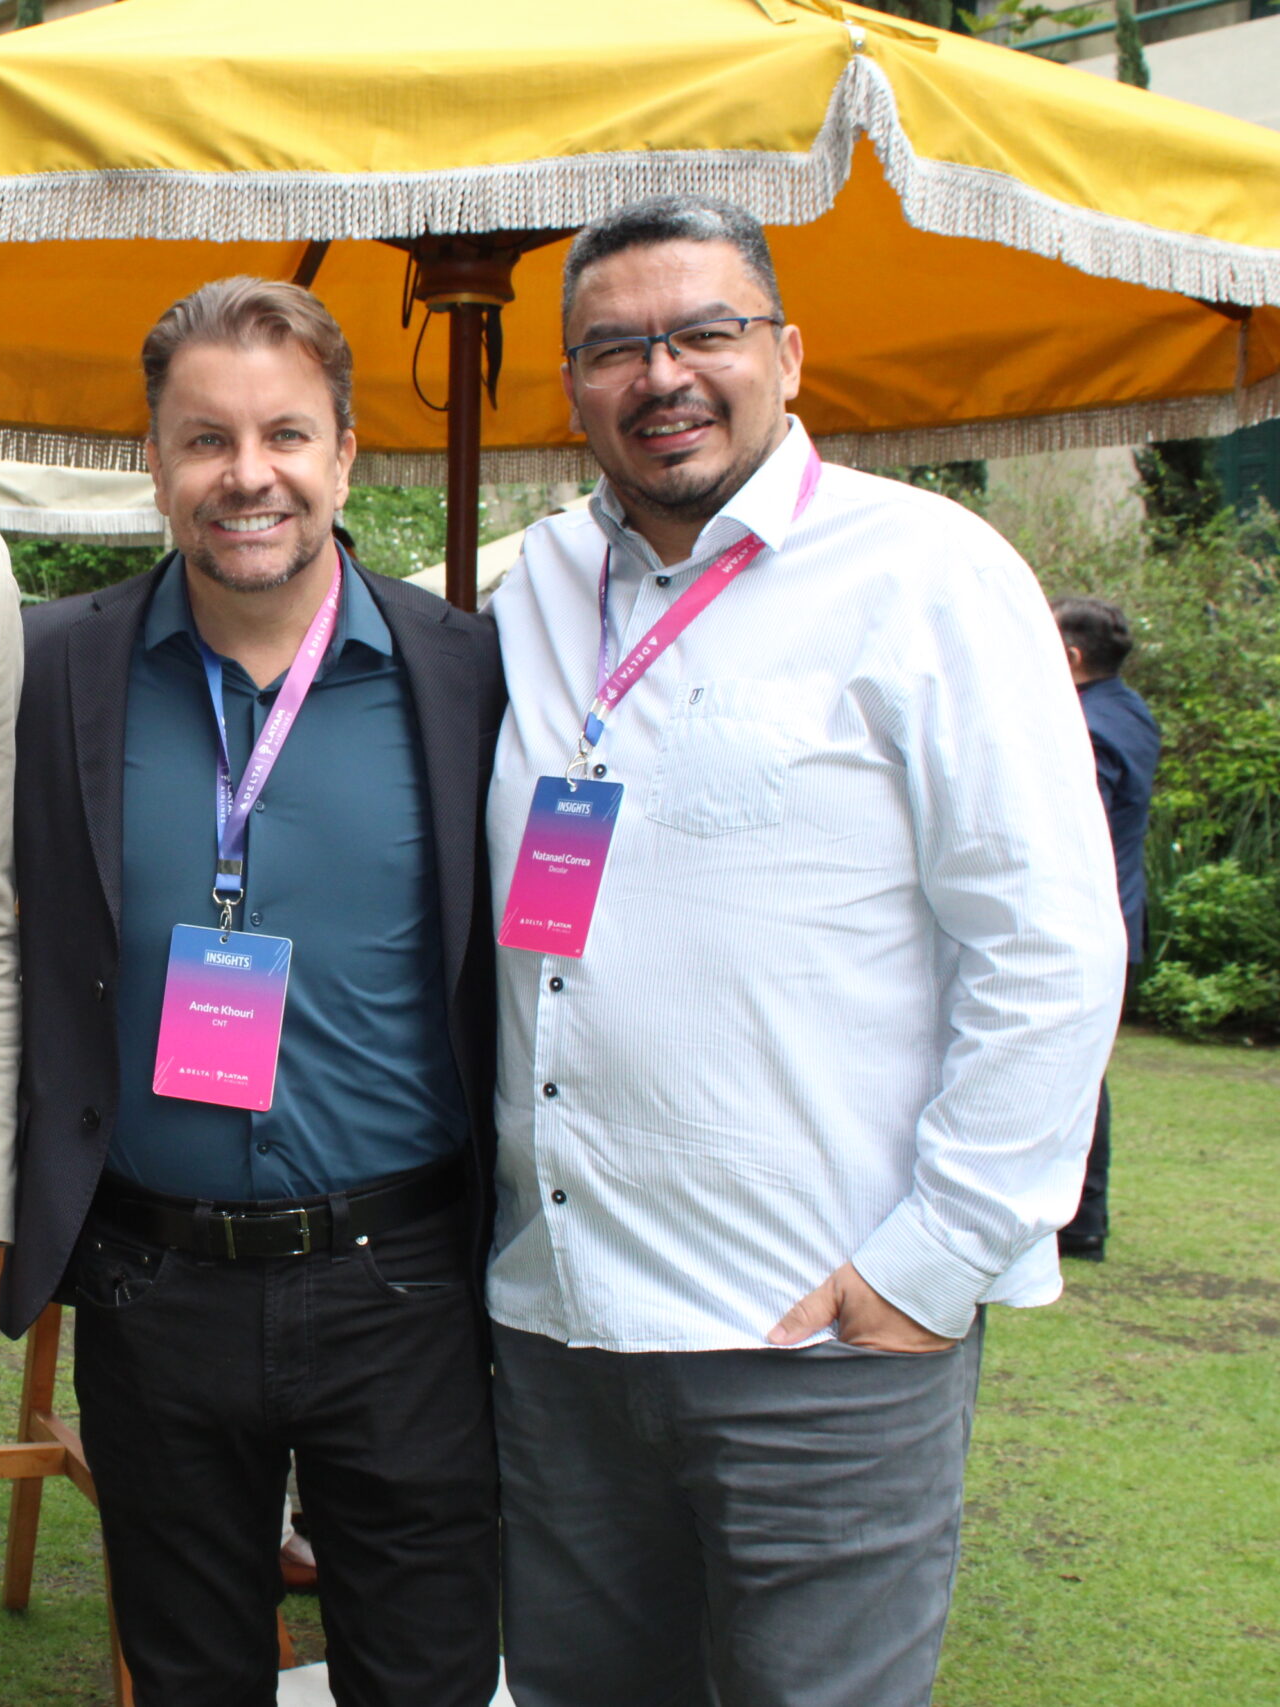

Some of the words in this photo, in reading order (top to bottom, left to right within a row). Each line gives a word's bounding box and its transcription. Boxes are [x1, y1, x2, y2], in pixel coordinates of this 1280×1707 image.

[311, 617, 331, 648] DELTA
[619, 646, 651, 679] DELTA
[274, 711, 294, 748] AIRLINES
[243, 764, 264, 801] DELTA
[264, 708, 286, 745] LATAM
[557, 801, 591, 814] INSIGHTS
[532, 850, 565, 863] Natanael
[565, 854, 591, 867] Correa
[524, 918, 543, 926] DELTA
[552, 921, 572, 929] LATAM
[206, 952, 251, 968] INSIGHTS
[189, 1001, 220, 1014] Andre
[221, 1005, 255, 1019] Khouri
[211, 1019, 227, 1027] CNT
[185, 1068, 210, 1077] DELTA
[223, 1072, 249, 1081] LATAM
